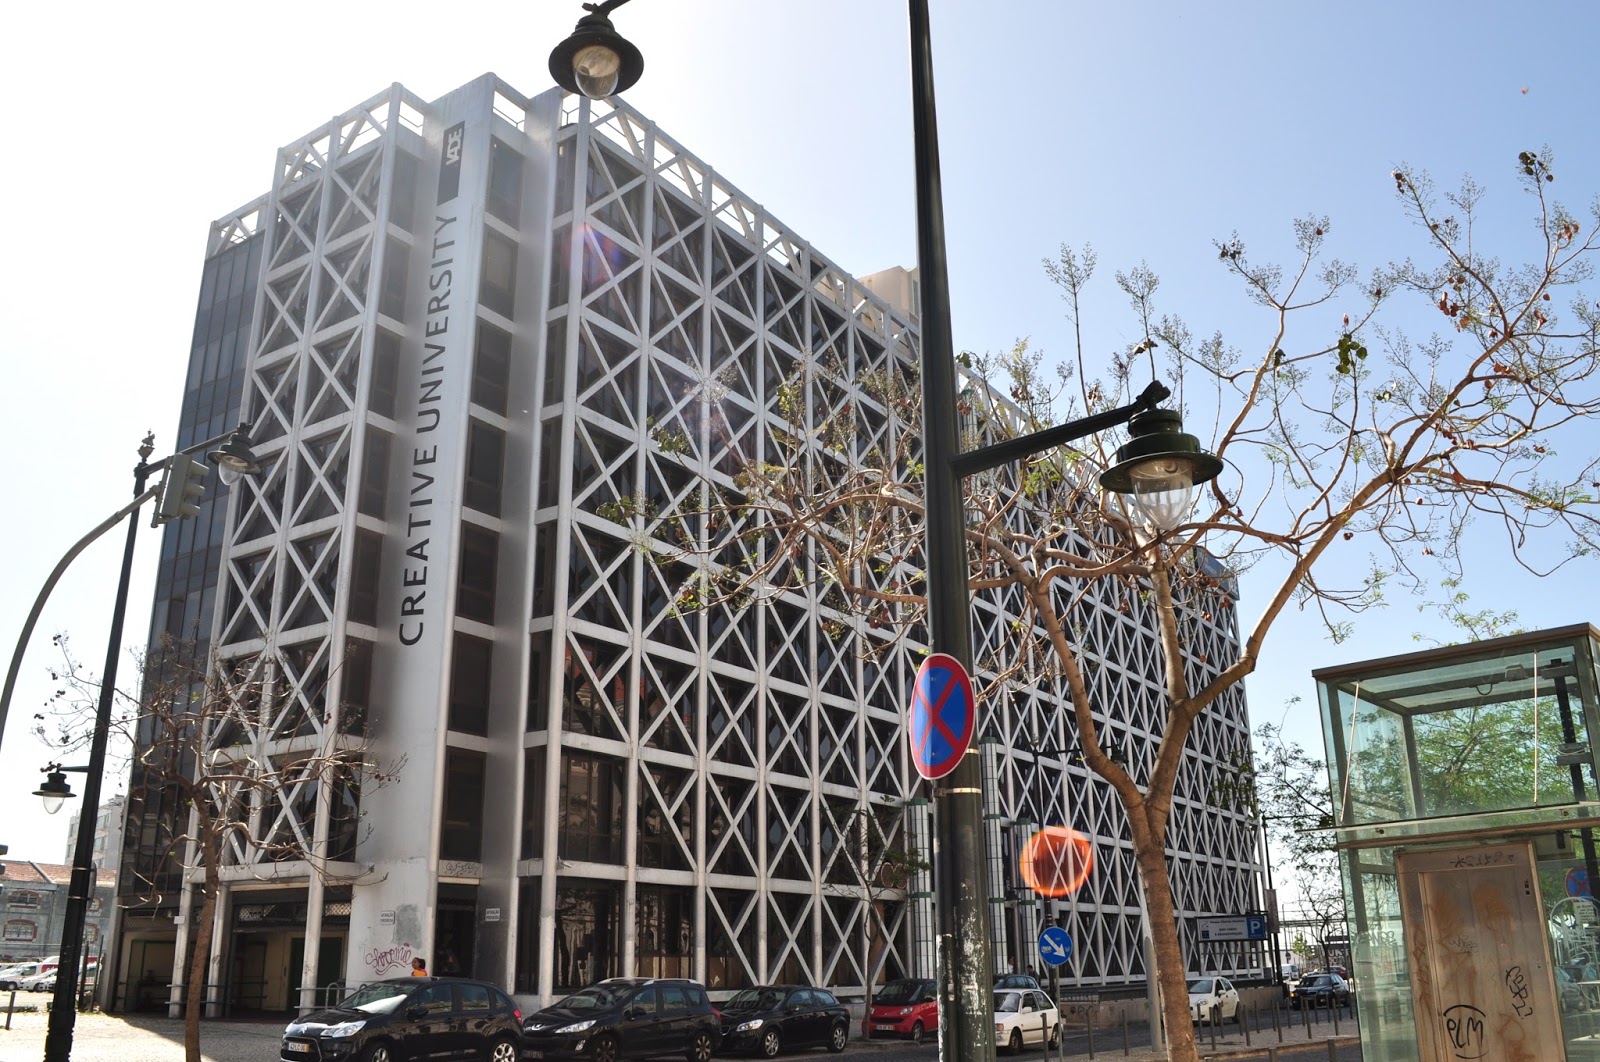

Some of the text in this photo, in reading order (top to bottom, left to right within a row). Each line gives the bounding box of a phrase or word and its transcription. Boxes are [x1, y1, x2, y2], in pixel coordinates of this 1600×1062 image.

[446, 128, 462, 167] IADE
[399, 215, 457, 648] CREATIVE UNIVERSITY
[1251, 921, 1260, 934] P
[1446, 1016, 1485, 1049] PLM
